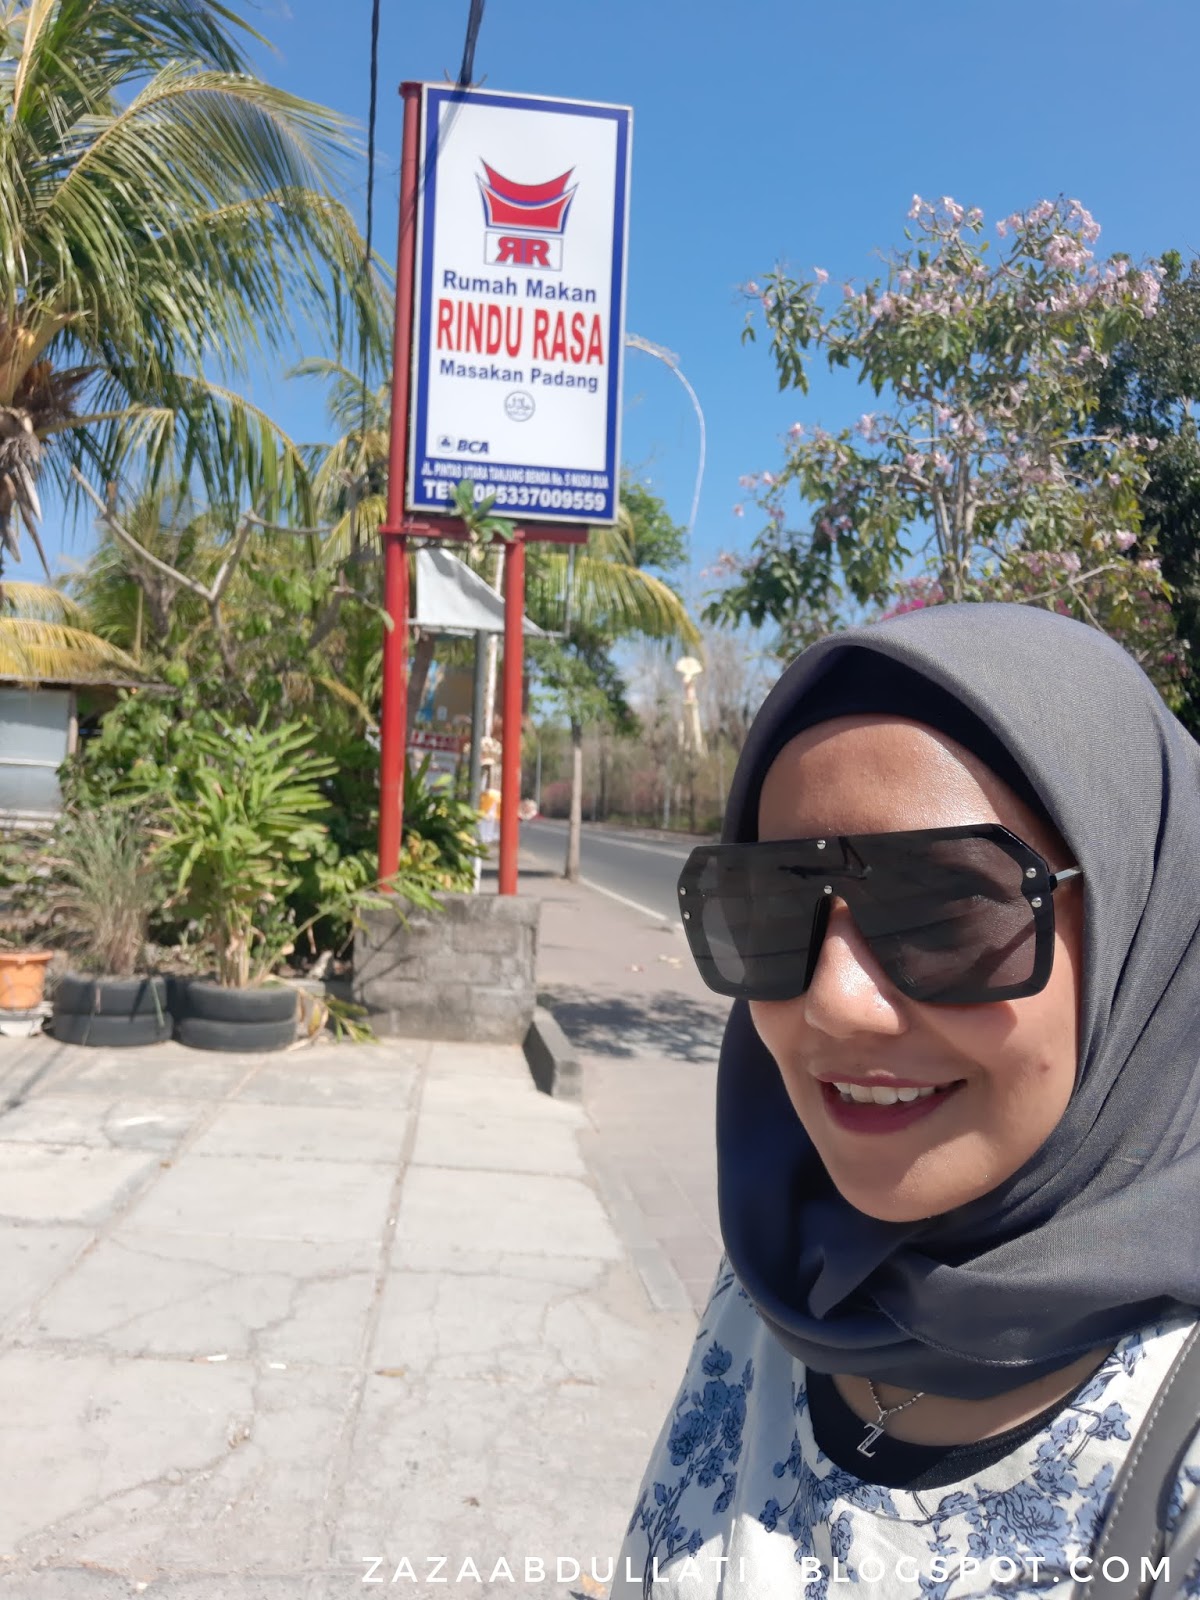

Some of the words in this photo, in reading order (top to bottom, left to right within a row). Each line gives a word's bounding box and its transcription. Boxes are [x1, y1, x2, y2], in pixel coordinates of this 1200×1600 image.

[443, 269, 518, 297] Rumah
[525, 278, 597, 304] Makan
[436, 298, 524, 359] RINDU
[532, 308, 605, 366] RASA
[439, 358, 524, 384] Masakan
[530, 368, 598, 393] Padang
[457, 439, 489, 454] BCA
